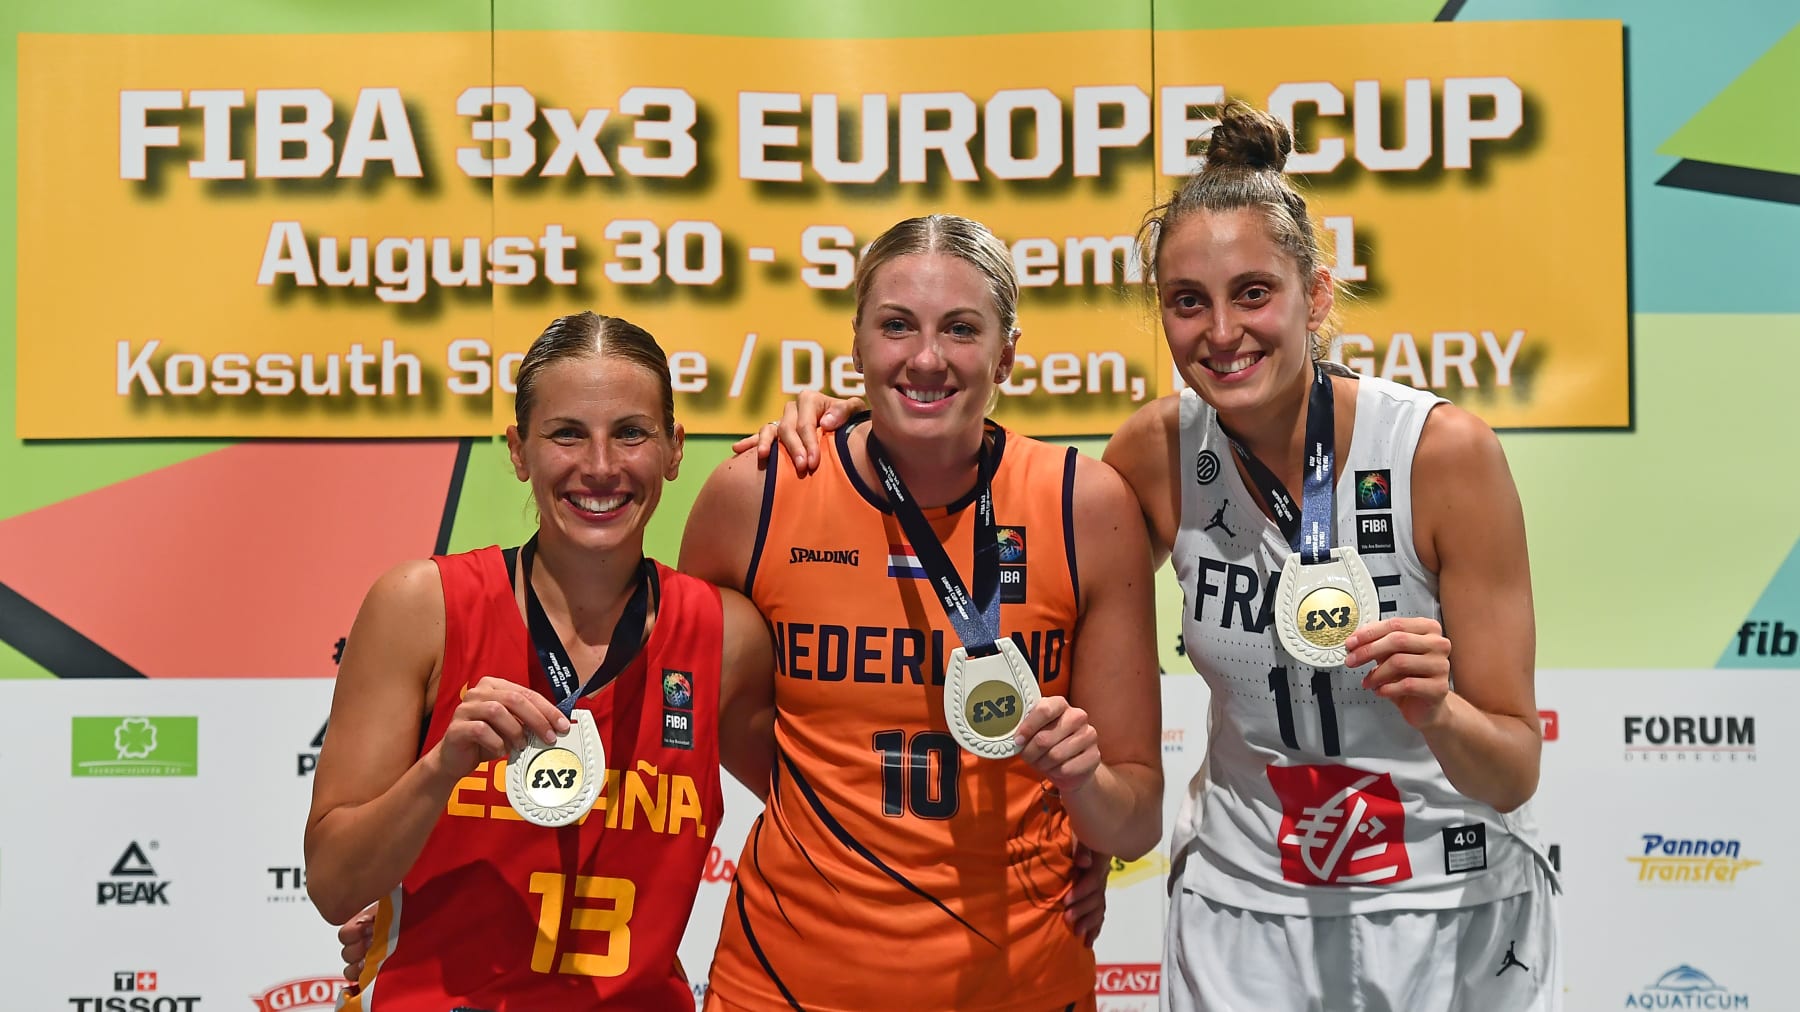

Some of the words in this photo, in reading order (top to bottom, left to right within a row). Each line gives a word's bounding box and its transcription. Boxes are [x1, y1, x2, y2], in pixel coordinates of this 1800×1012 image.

[118, 87, 424, 180] FIBA
[455, 86, 698, 178] 3x3
[738, 84, 1225, 183] EUROPE
[1267, 76, 1524, 174] CUP
[256, 220, 578, 303] August
[603, 218, 723, 286] 30
[1323, 215, 1368, 281] 1
[115, 339, 422, 396] Kossuth
[781, 339, 1146, 402] Decen,
[1361, 519, 1388, 533] FIBA
[789, 547, 860, 567] SPALDING
[1000, 570, 1021, 584] IBA
[769, 622, 1066, 687] NEDERLND
[665, 714, 688, 730] FIBA
[1268, 667, 1342, 757] 11
[1623, 716, 1756, 745] FORUM
[871, 729, 962, 820] 10
[1454, 831, 1477, 846] 40
[1641, 834, 1741, 858] Pannon
[1626, 857, 1742, 882] Transfer
[96, 880, 172, 905] PEAK
[528, 871, 636, 977] 13
[68, 996, 201, 1012] TISSOT
[1624, 993, 1749, 1010] AQUATICUM
